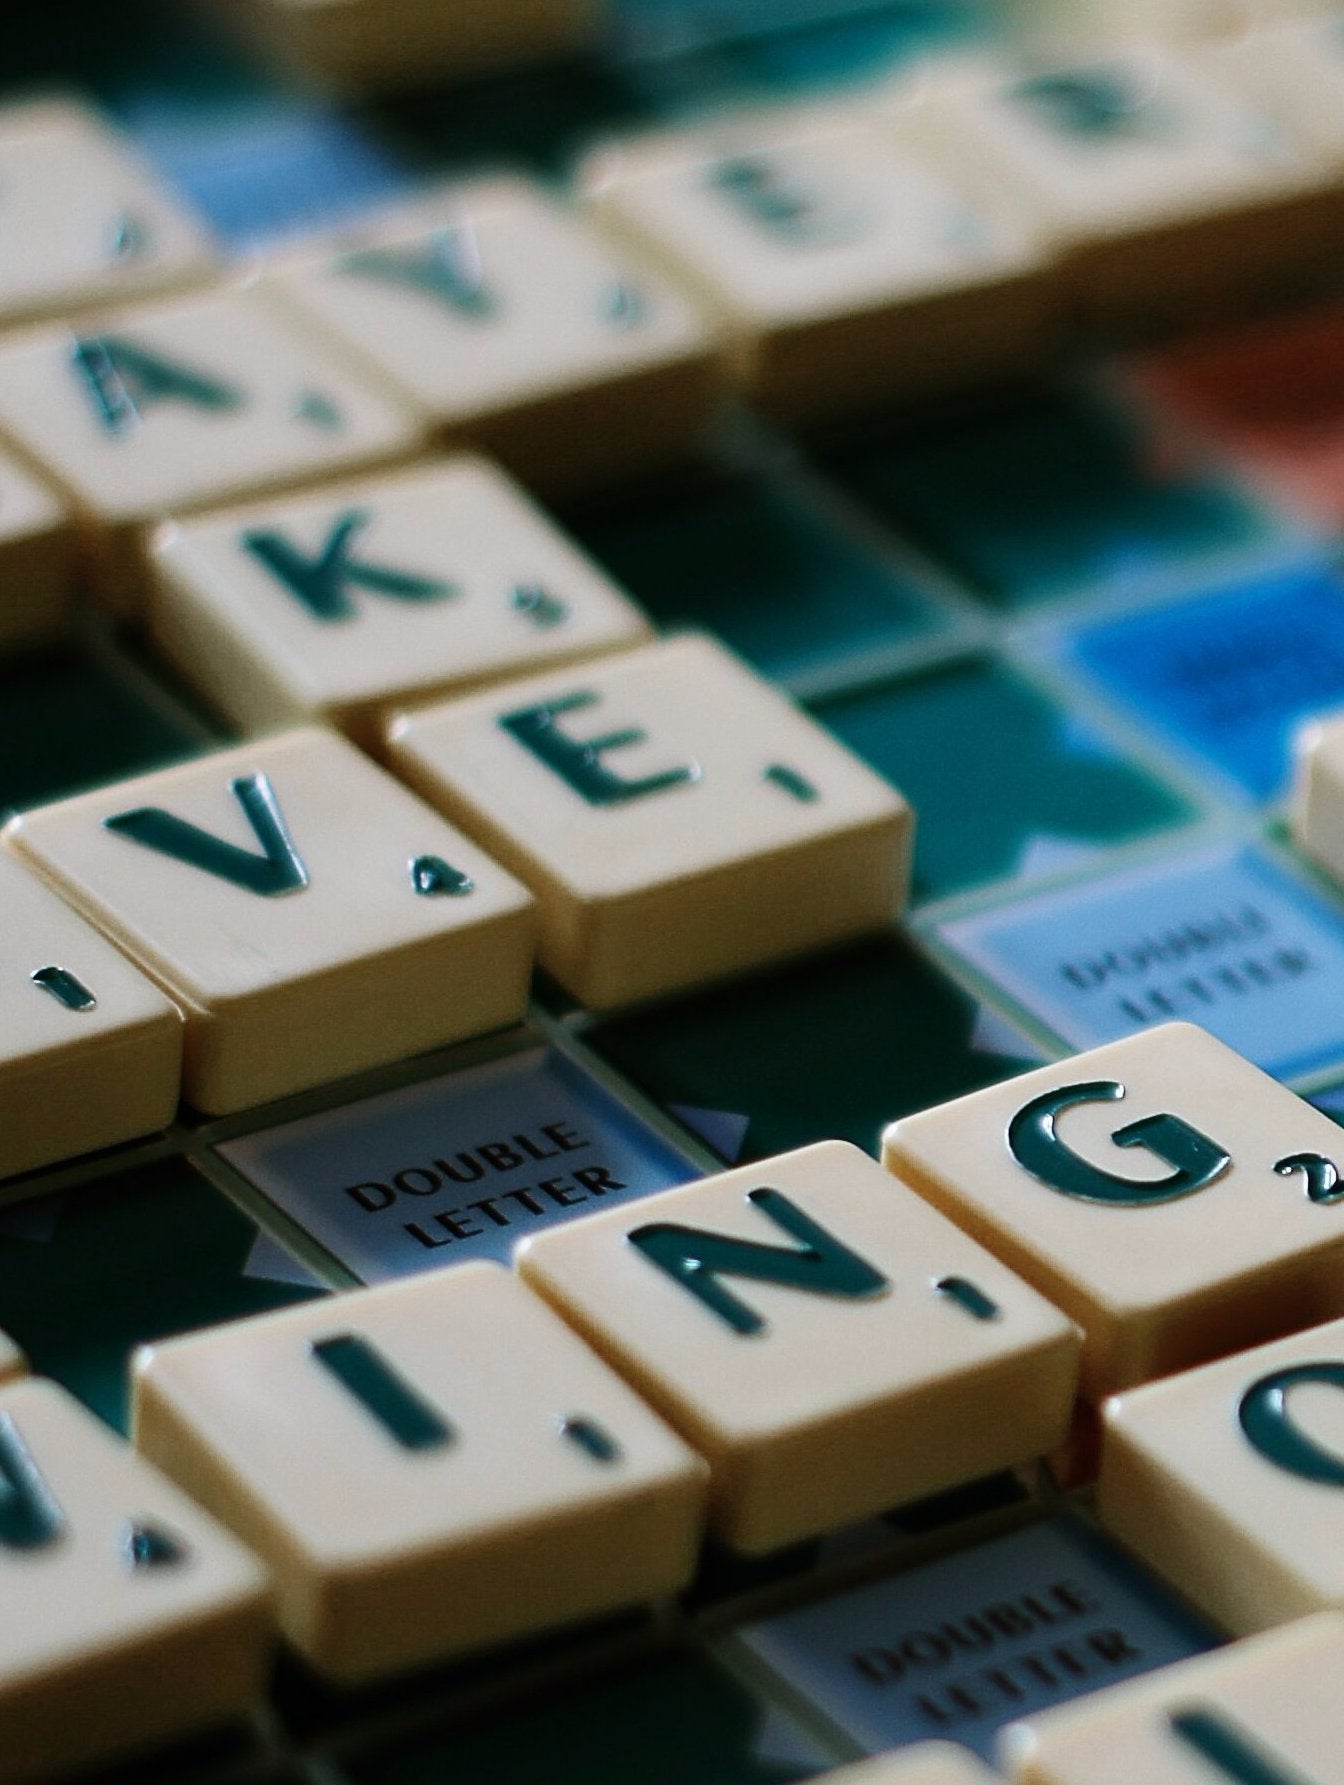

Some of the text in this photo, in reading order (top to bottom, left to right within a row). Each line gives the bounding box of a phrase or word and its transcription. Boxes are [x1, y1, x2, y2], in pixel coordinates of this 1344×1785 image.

[69, 332, 243, 437] A
[240, 507, 458, 625] K
[496, 690, 820, 808] E 1
[104, 771, 308, 897] V
[32, 966, 97, 1012] 1
[345, 1121, 591, 1213] DOUBLE
[1007, 1081, 1233, 1208] G
[402, 1166, 628, 1250] LETTER
[627, 1187, 1000, 1336] N 1
[310, 1333, 621, 1464] I 1
[852, 1580, 1092, 1688] DOUBLE
[914, 1627, 1142, 1728] LETTER
